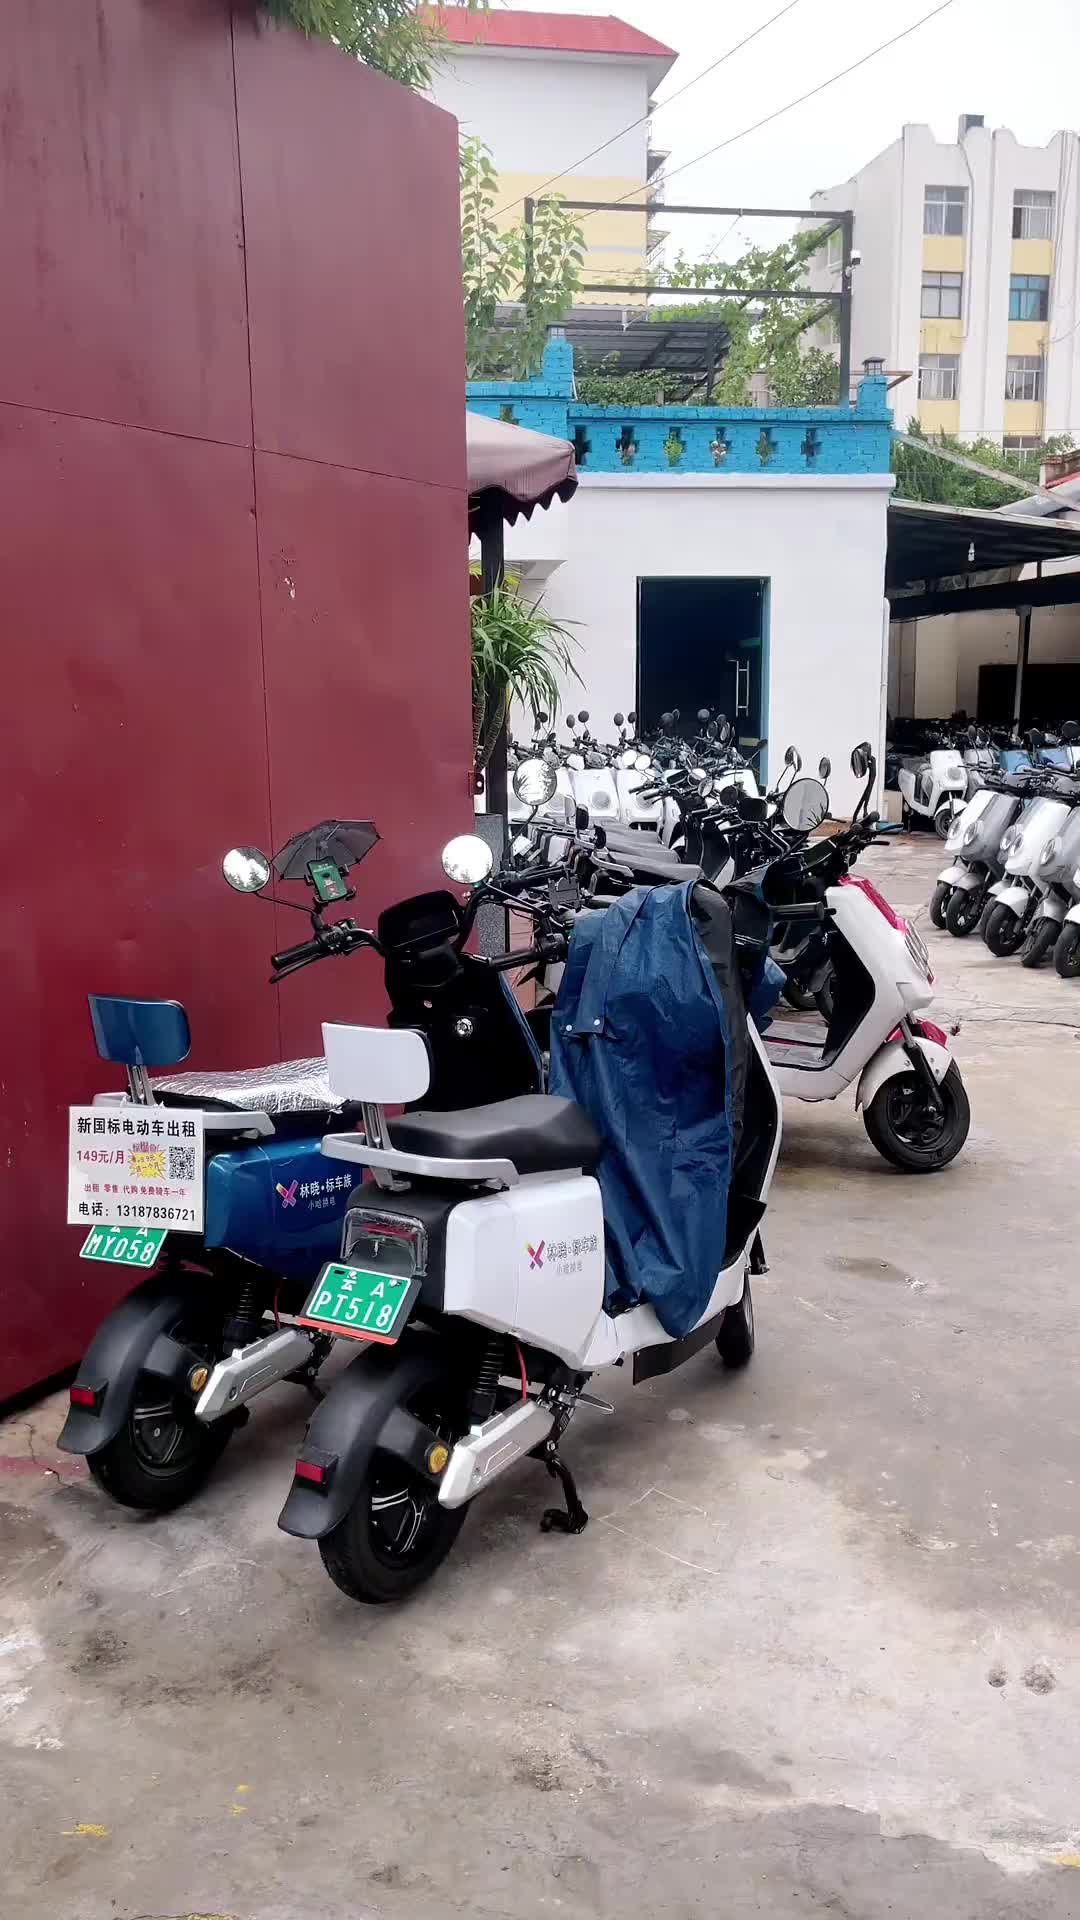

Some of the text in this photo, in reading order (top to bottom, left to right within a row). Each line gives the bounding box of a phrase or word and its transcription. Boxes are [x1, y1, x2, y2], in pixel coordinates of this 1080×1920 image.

[77, 1117, 196, 1138] 新国标电动车出租
[76, 1150, 125, 1165] 149元/月
[84, 1183, 187, 1197] 出租 零售 代购 免费骑车一年
[117, 1205, 195, 1221] 13187836721
[85, 1233, 156, 1262] MY058
[370, 1282, 385, 1298] A
[313, 1291, 393, 1328] PT518
